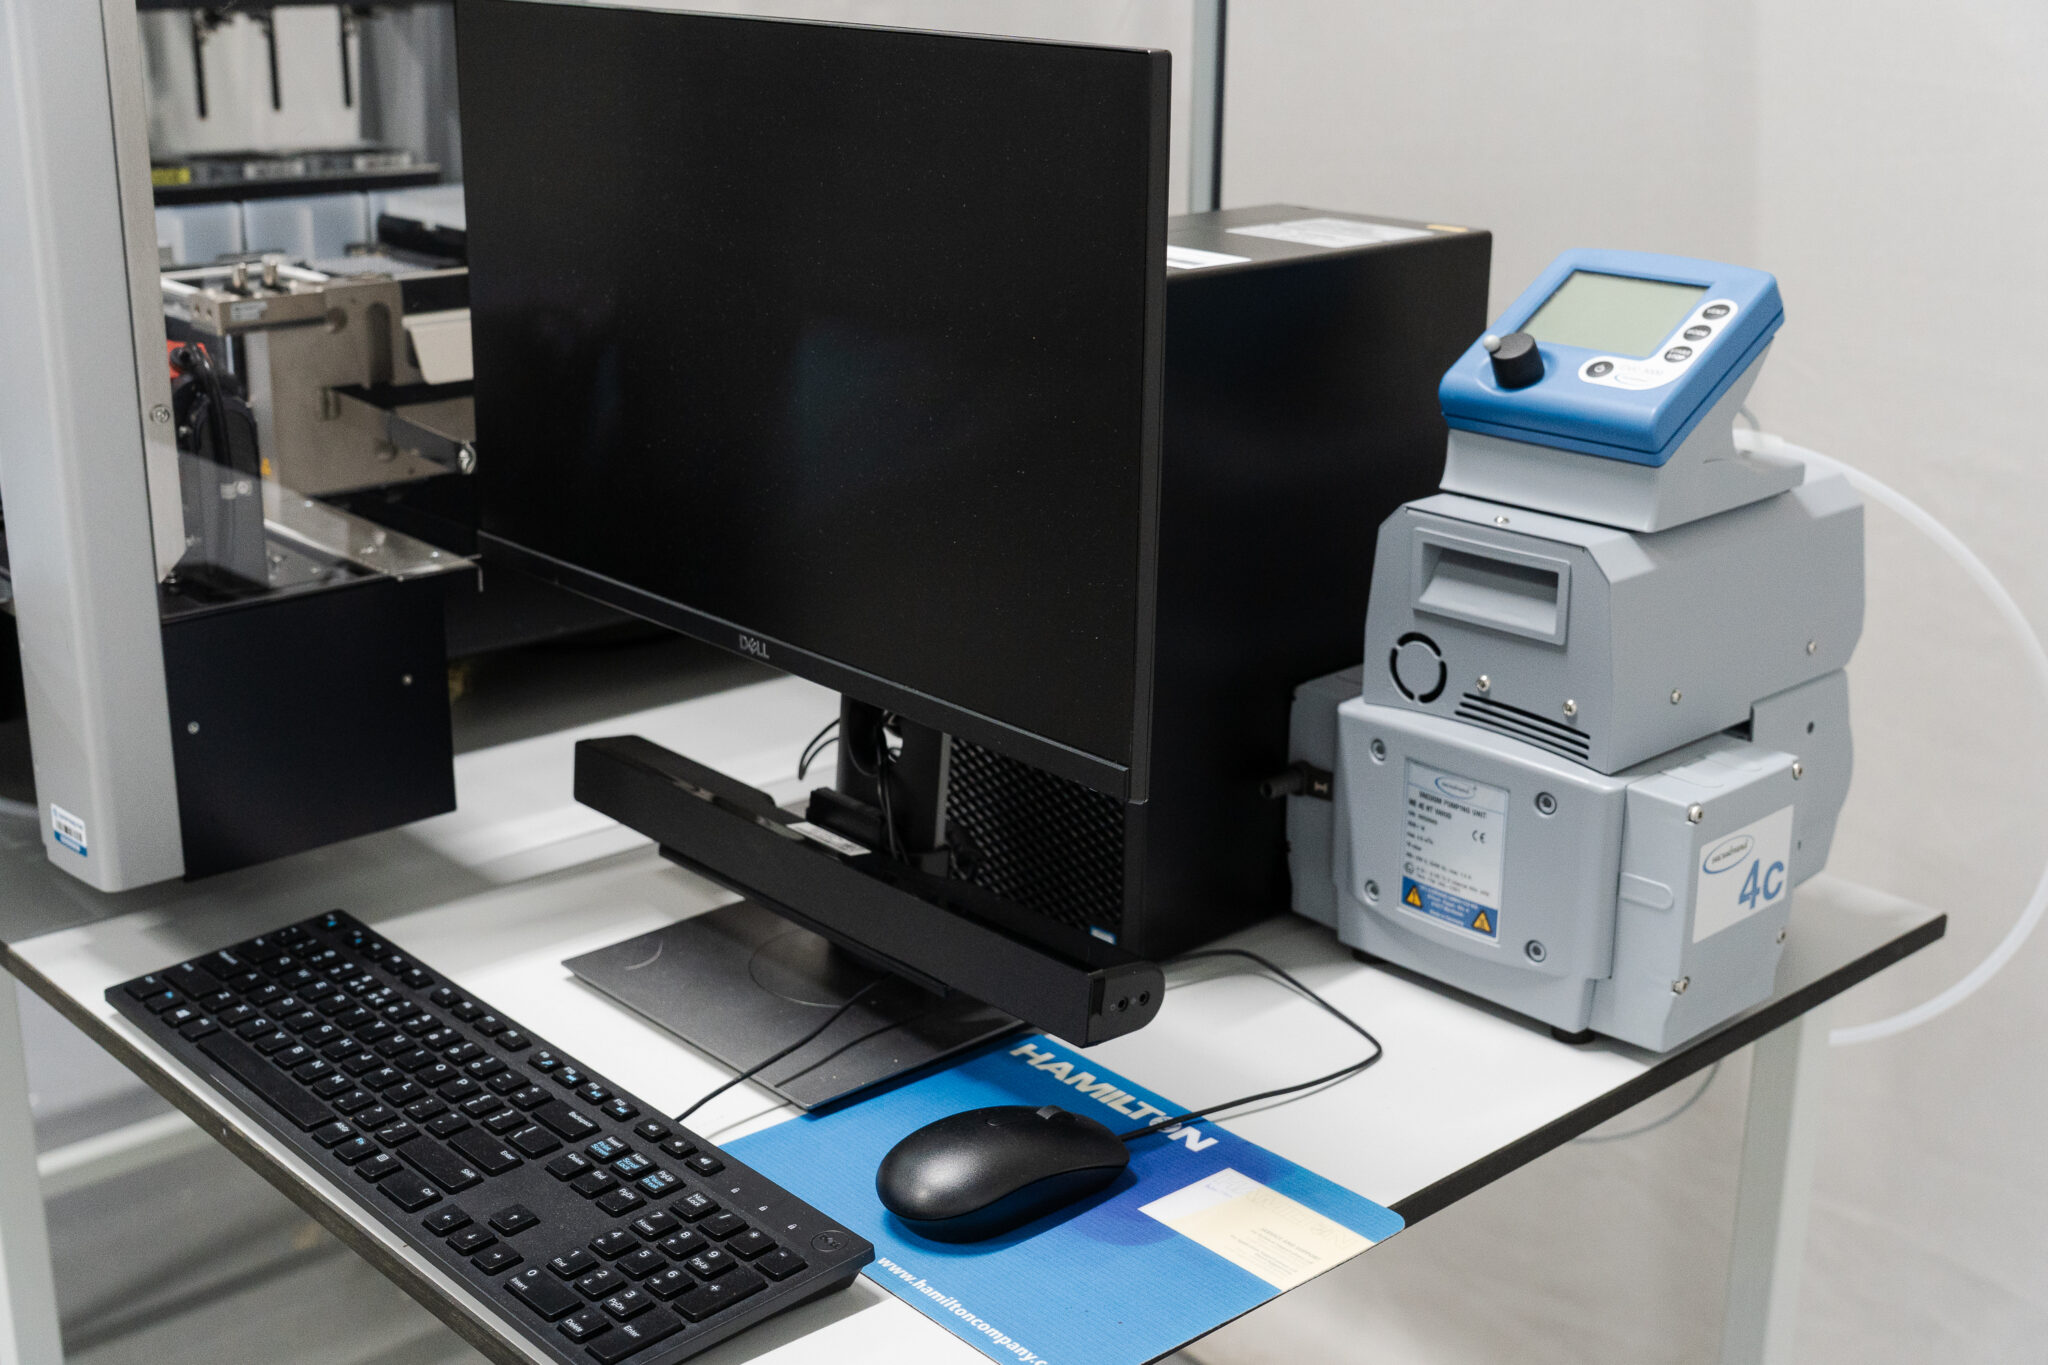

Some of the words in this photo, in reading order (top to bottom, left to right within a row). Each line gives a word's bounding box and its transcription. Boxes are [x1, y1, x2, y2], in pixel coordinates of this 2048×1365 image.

[739, 633, 770, 660] DELL
[1738, 858, 1784, 910] 4C
[282, 997, 294, 1006] D
[236, 1005, 248, 1013] X
[340, 1038, 352, 1047] H
[393, 1035, 405, 1043] U
[311, 1060, 324, 1069] N
[380, 1068, 394, 1076] K
[331, 1075, 344, 1084] M
[1009, 1043, 1219, 1152] HAMILTON
[568, 1153, 584, 1165] Delete
[616, 1159, 631, 1170] Lock
[623, 1158, 641, 1169] Scroll
[632, 1154, 648, 1165] Home
[592, 1170, 608, 1180] End
[421, 1188, 435, 1196] Ctrl
[618, 1188, 635, 1200] PgDn
[686, 1196, 701, 1207] Lock
[694, 1193, 707, 1204] Num
[636, 1219, 655, 1231] Home
[679, 1231, 692, 1239] 8
[638, 1250, 652, 1258] 5
[554, 1258, 567, 1267] End
[691, 1257, 709, 1269] PgUp
[596, 1270, 609, 1278] 2
[666, 1270, 680, 1278] 6
[511, 1277, 528, 1290] Insert
[624, 1290, 638, 1299] 3
[607, 1298, 624, 1310] PgDn
[563, 1318, 583, 1332] Delete
[622, 1325, 640, 1337] Enter
